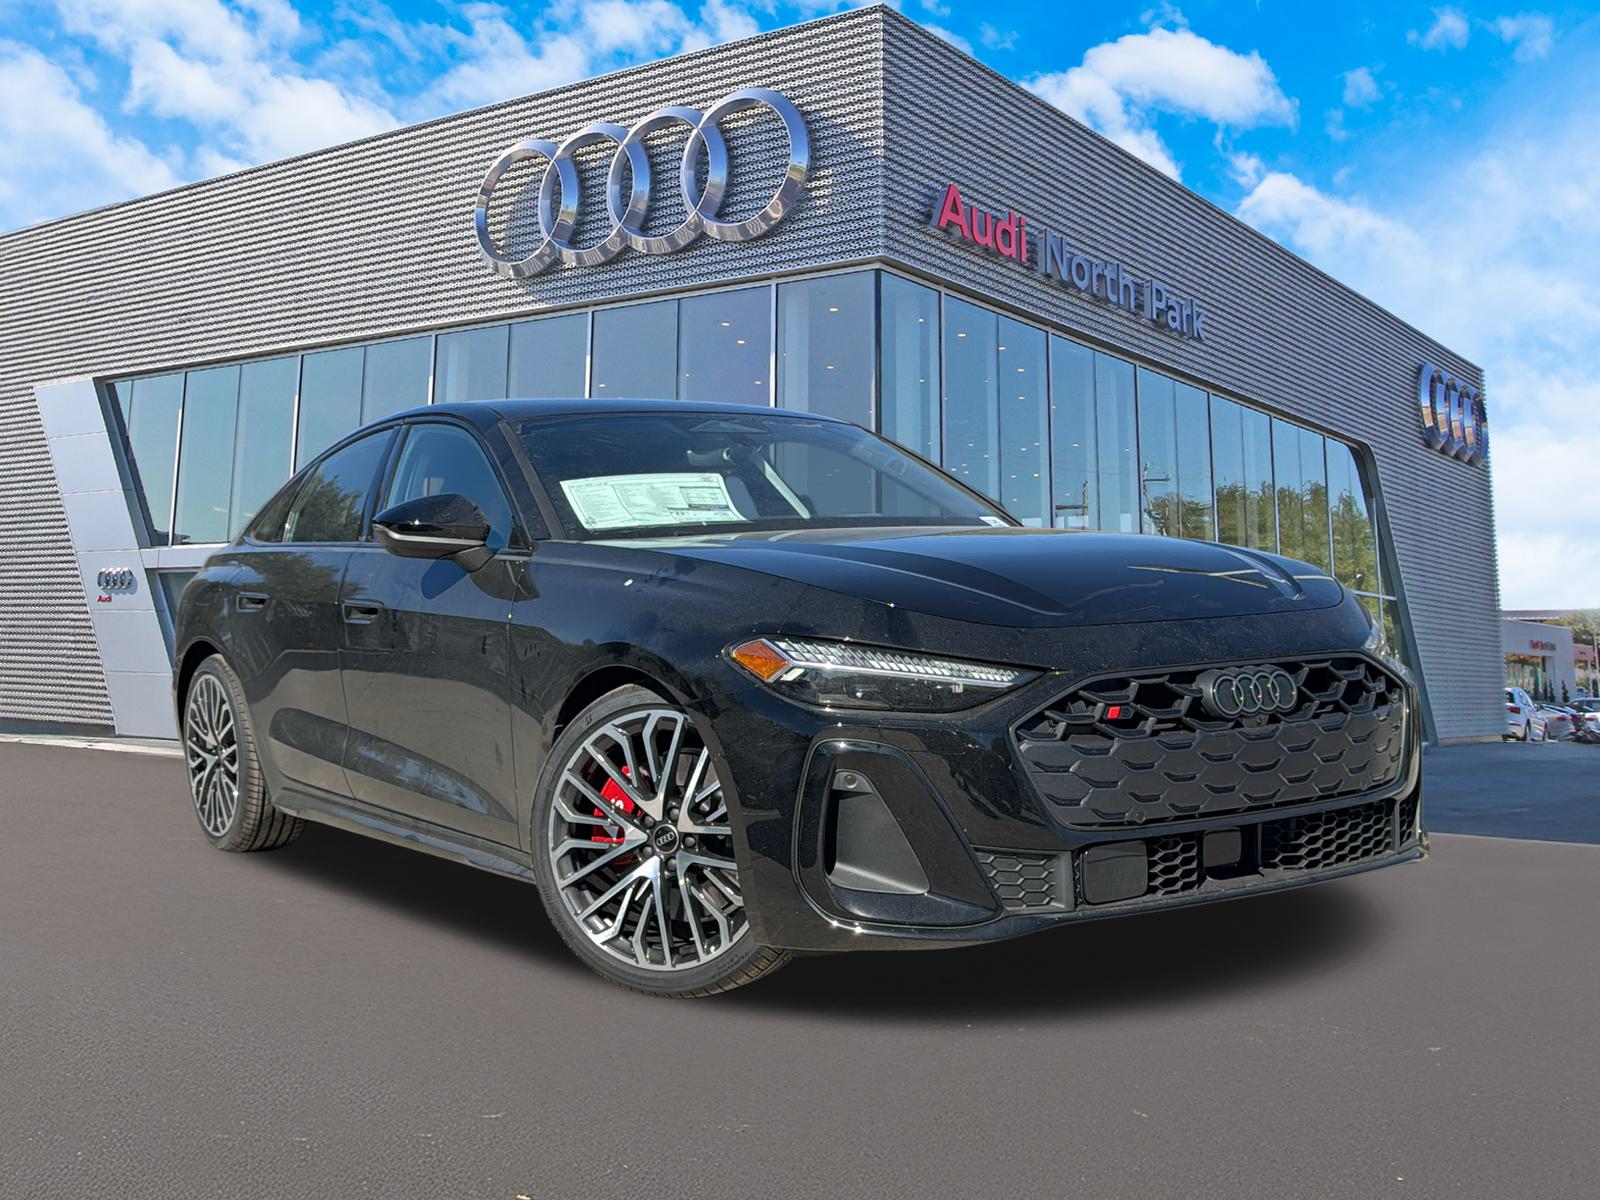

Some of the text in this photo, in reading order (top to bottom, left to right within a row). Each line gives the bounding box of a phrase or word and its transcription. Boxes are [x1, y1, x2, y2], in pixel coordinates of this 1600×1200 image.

[936, 183, 1208, 341] Audi North Park
